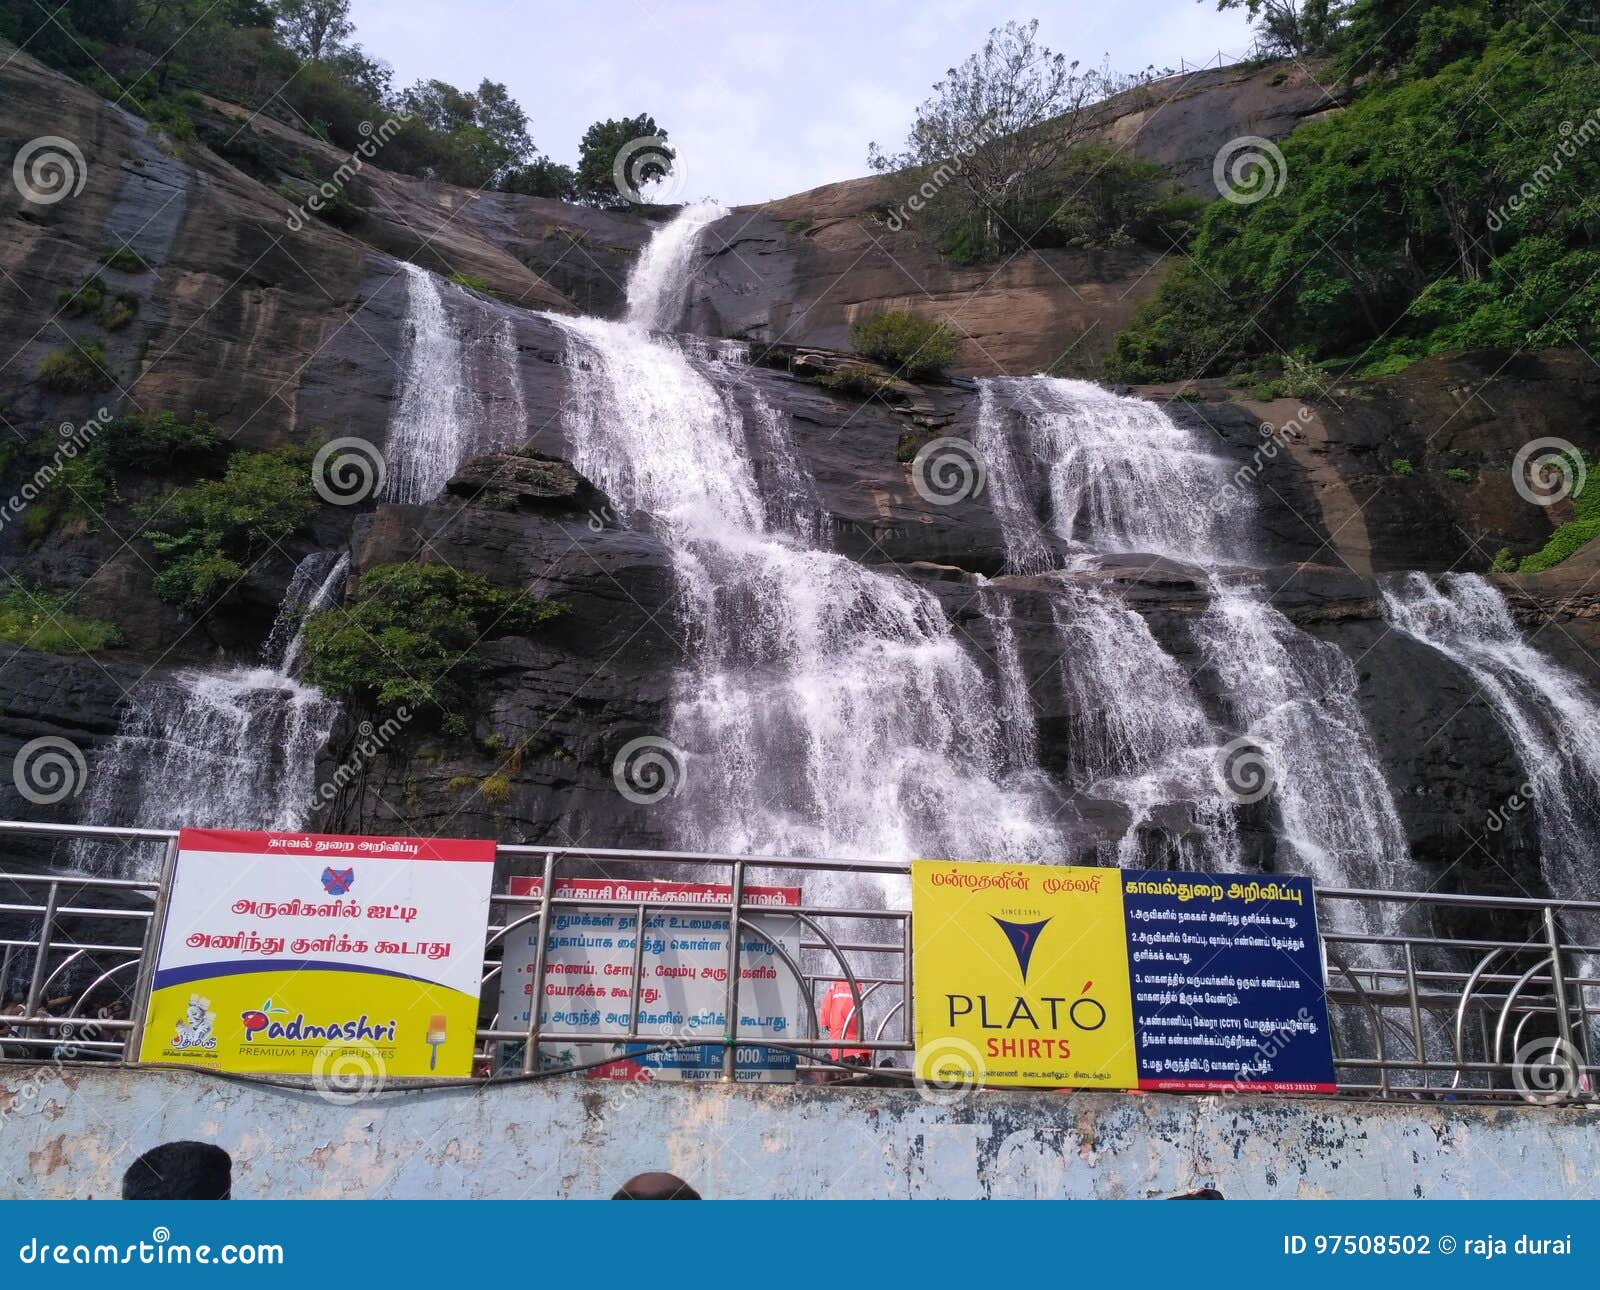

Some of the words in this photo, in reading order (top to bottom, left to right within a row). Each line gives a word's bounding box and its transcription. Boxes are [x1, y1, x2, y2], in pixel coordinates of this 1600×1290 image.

[268, 837, 312, 849] காவல்
[315, 841, 355, 852] துறை
[358, 841, 418, 855] அறிவிப்பு
[931, 868, 1030, 893] மன்மதனின்
[1042, 875, 1103, 895] முகவரி
[1125, 877, 1224, 903] காவல்துறை
[1227, 882, 1303, 906] அறிவிப்பு
[231, 898, 362, 919] அருவிகளில்
[1001, 908, 1021, 916] SINCE
[186, 930, 285, 956] அணிந்து
[290, 933, 369, 954] குளிக்க
[374, 940, 452, 960] கூடாது
[670, 938, 722, 952] கொள்ள
[945, 981, 1107, 1031] PLATÓ
[241, 1010, 397, 1042] Padmashri
[1219, 1018, 1242, 1030] (CCTV)
[239, 1047, 295, 1057] PREMIUM
[301, 1048, 335, 1057] PAINT
[341, 1049, 395, 1060] BRUSHES
[986, 1038, 1071, 1059] SHIRTS
[610, 1066, 628, 1078] Just
[681, 1070, 709, 1080] READY
